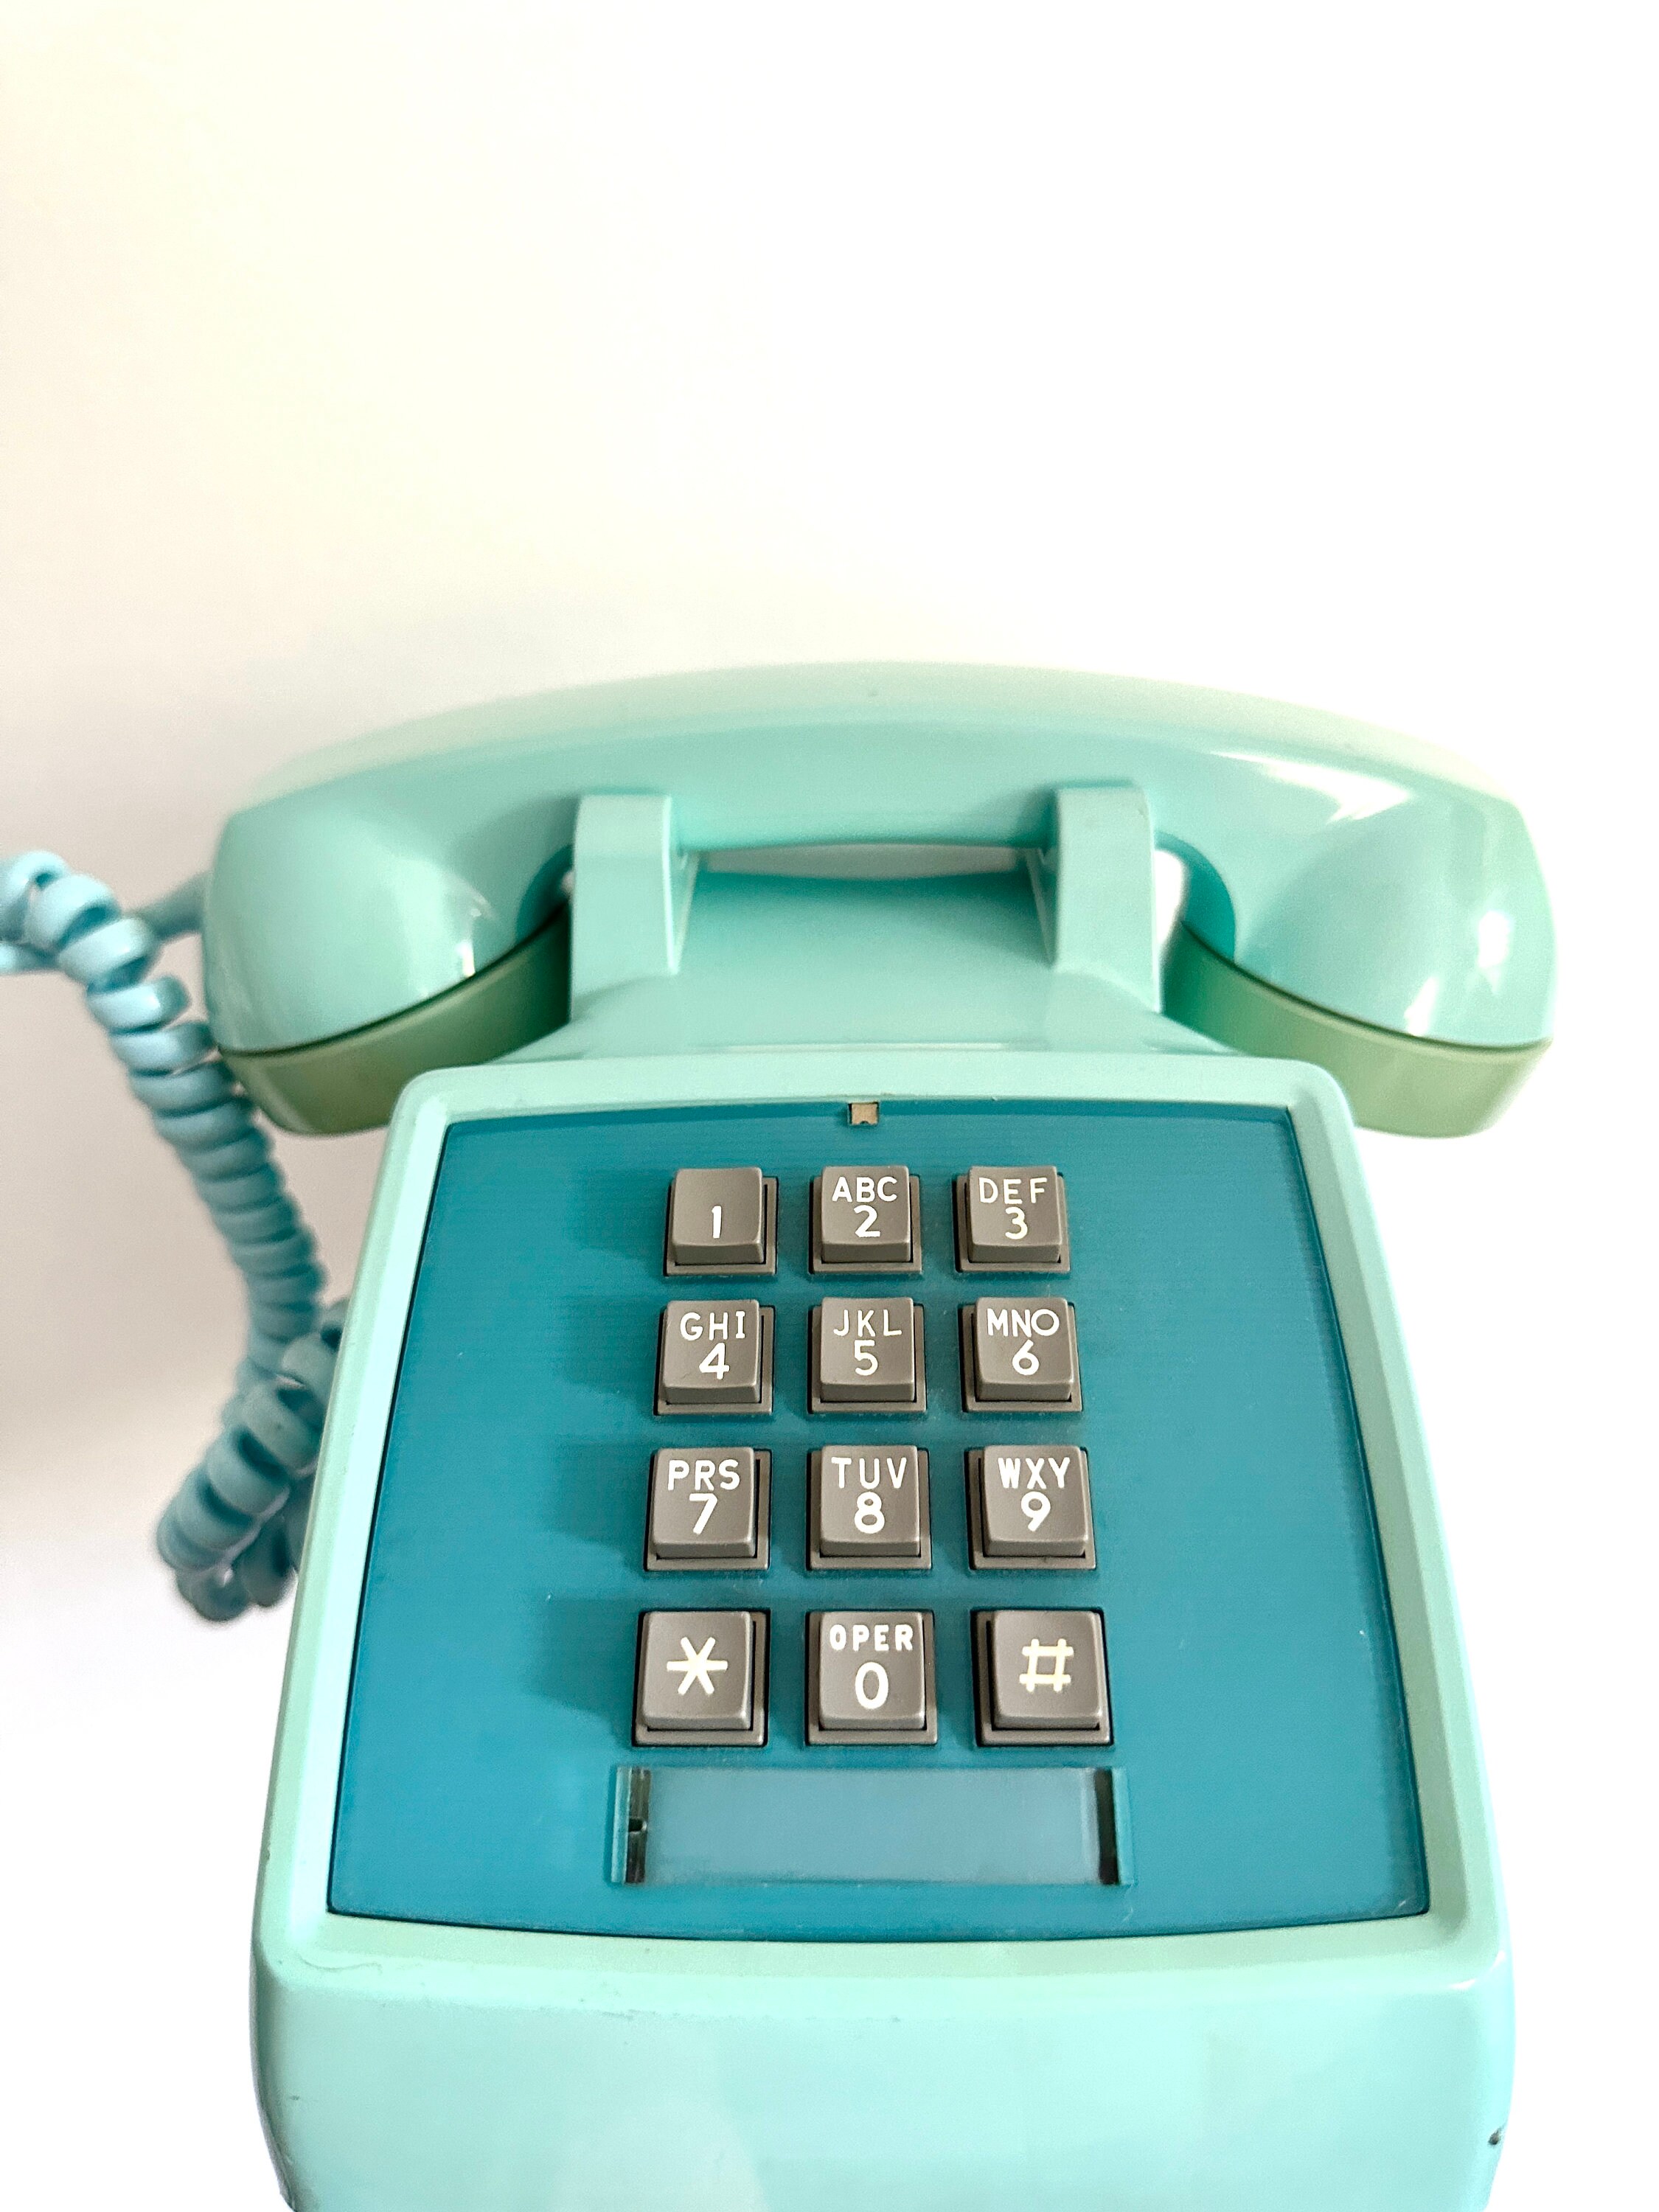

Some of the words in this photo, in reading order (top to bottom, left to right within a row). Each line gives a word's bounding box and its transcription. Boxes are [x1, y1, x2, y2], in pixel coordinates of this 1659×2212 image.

[832, 1176, 897, 1203] ABC
[978, 1177, 1048, 1205] DEF
[711, 1206, 722, 1239] 1
[853, 1204, 880, 1238] 2
[1005, 1206, 1028, 1240] 3
[680, 1310, 745, 1341] GHI
[832, 1309, 902, 1338] JKL
[987, 1308, 1060, 1338] MNO
[698, 1342, 730, 1380] 4
[854, 1339, 878, 1376] 5
[1012, 1339, 1040, 1376] 6
[667, 1458, 740, 1491] PRS
[830, 1456, 907, 1490] TUV
[997, 1457, 1071, 1490] WXY
[689, 1492, 718, 1535] 7
[854, 1491, 885, 1534] 8
[1020, 1491, 1051, 1532] 9
[829, 1624, 914, 1652] OPER
[1018, 1638, 1074, 1693] #
[854, 1661, 889, 1711] 0
